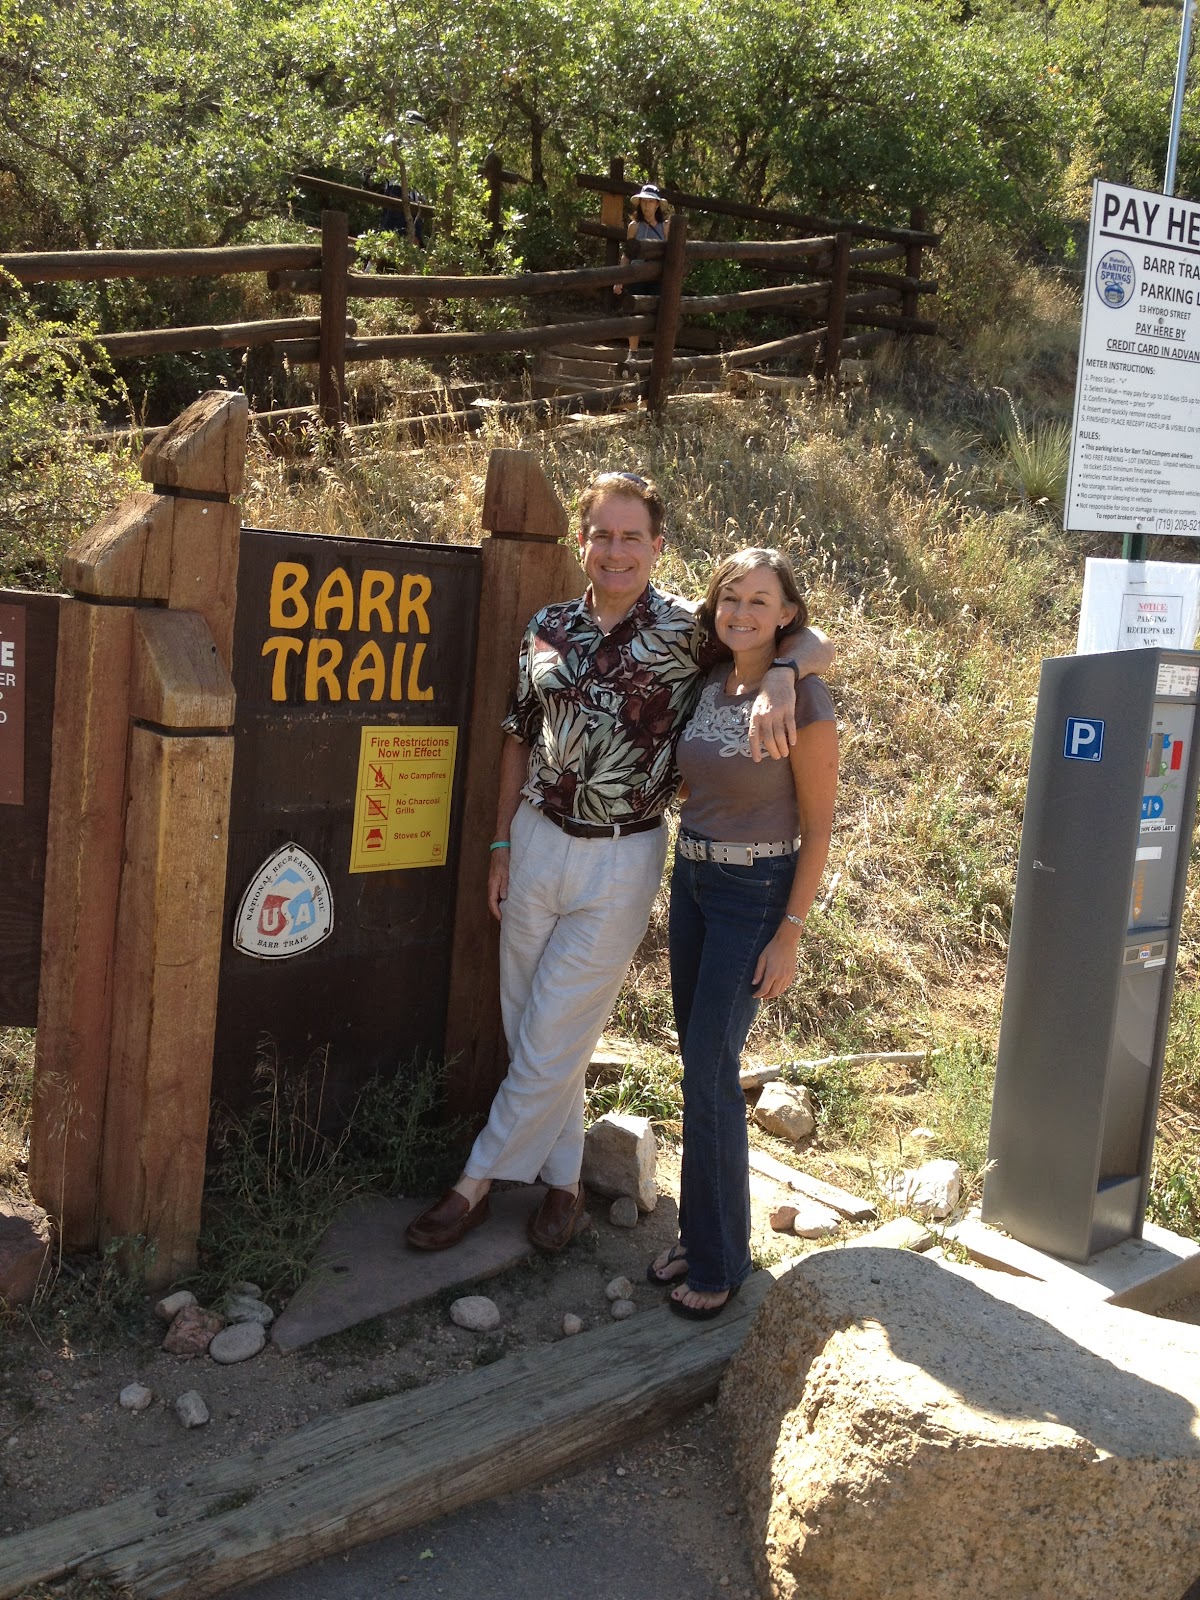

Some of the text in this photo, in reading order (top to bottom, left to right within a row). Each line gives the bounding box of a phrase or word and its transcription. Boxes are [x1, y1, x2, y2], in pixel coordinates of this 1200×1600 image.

[1102, 193, 1200, 246] PAY HE
[1101, 261, 1132, 274] MANITOU
[1143, 256, 1200, 280] BARR TRA
[1101, 271, 1132, 284] SPRINGS
[1140, 282, 1194, 305] PARKING
[1139, 305, 1192, 320] 13 HYDRO STREET
[1135, 322, 1186, 339] PAY HERE BY
[1107, 338, 1136, 352] CREDIT
[1137, 343, 1160, 355] CARD
[1161, 346, 1170, 357] IN
[1086, 358, 1156, 375] METER INSTRUCTIONS:
[1090, 374, 1103, 382] Press
[1103, 376, 1115, 384] Start
[1104, 386, 1117, 394] Value
[1142, 390, 1150, 398] for
[1088, 394, 1108, 403] Confirm
[1108, 397, 1129, 406] Payment
[1112, 409, 1128, 417] quickly
[1111, 418, 1126, 426] PLACE
[1126, 419, 1145, 427] RECEIPT
[1146, 421, 1166, 430] FACE-UP
[1171, 424, 1187, 433] VISIBLE
[1079, 430, 1101, 440] RULES:
[1095, 445, 1112, 453] parking
[1152, 450, 1170, 458] Campers
[1104, 455, 1124, 463] PARKING
[1120, 475, 1134, 483] parked
[1088, 493, 1106, 501] camping
[1113, 494, 1131, 502] sleeping
[1089, 503, 1113, 511] responsible
[1135, 506, 1152, 514] damage
[1156, 518, 1174, 533] (719)
[269, 561, 431, 634] BARR
[1138, 602, 1168, 611] NOTICE:
[1162, 627, 1176, 635] ARE
[1, 641, 15, 667] E
[261, 636, 434, 701] TRAIL
[371, 737, 449, 747] Fire Restrictions
[1071, 722, 1096, 755] P
[378, 747, 441, 758] Now in Effect
[398, 771, 446, 780] No Campfires
[408, 797, 440, 805] Charcoal
[393, 830, 432, 840] Stoves OK
[247, 874, 272, 921] NATIONAL
[272, 855, 316, 882] RECREATION
[262, 900, 312, 934] USA
[257, 939, 279, 949] BARR
